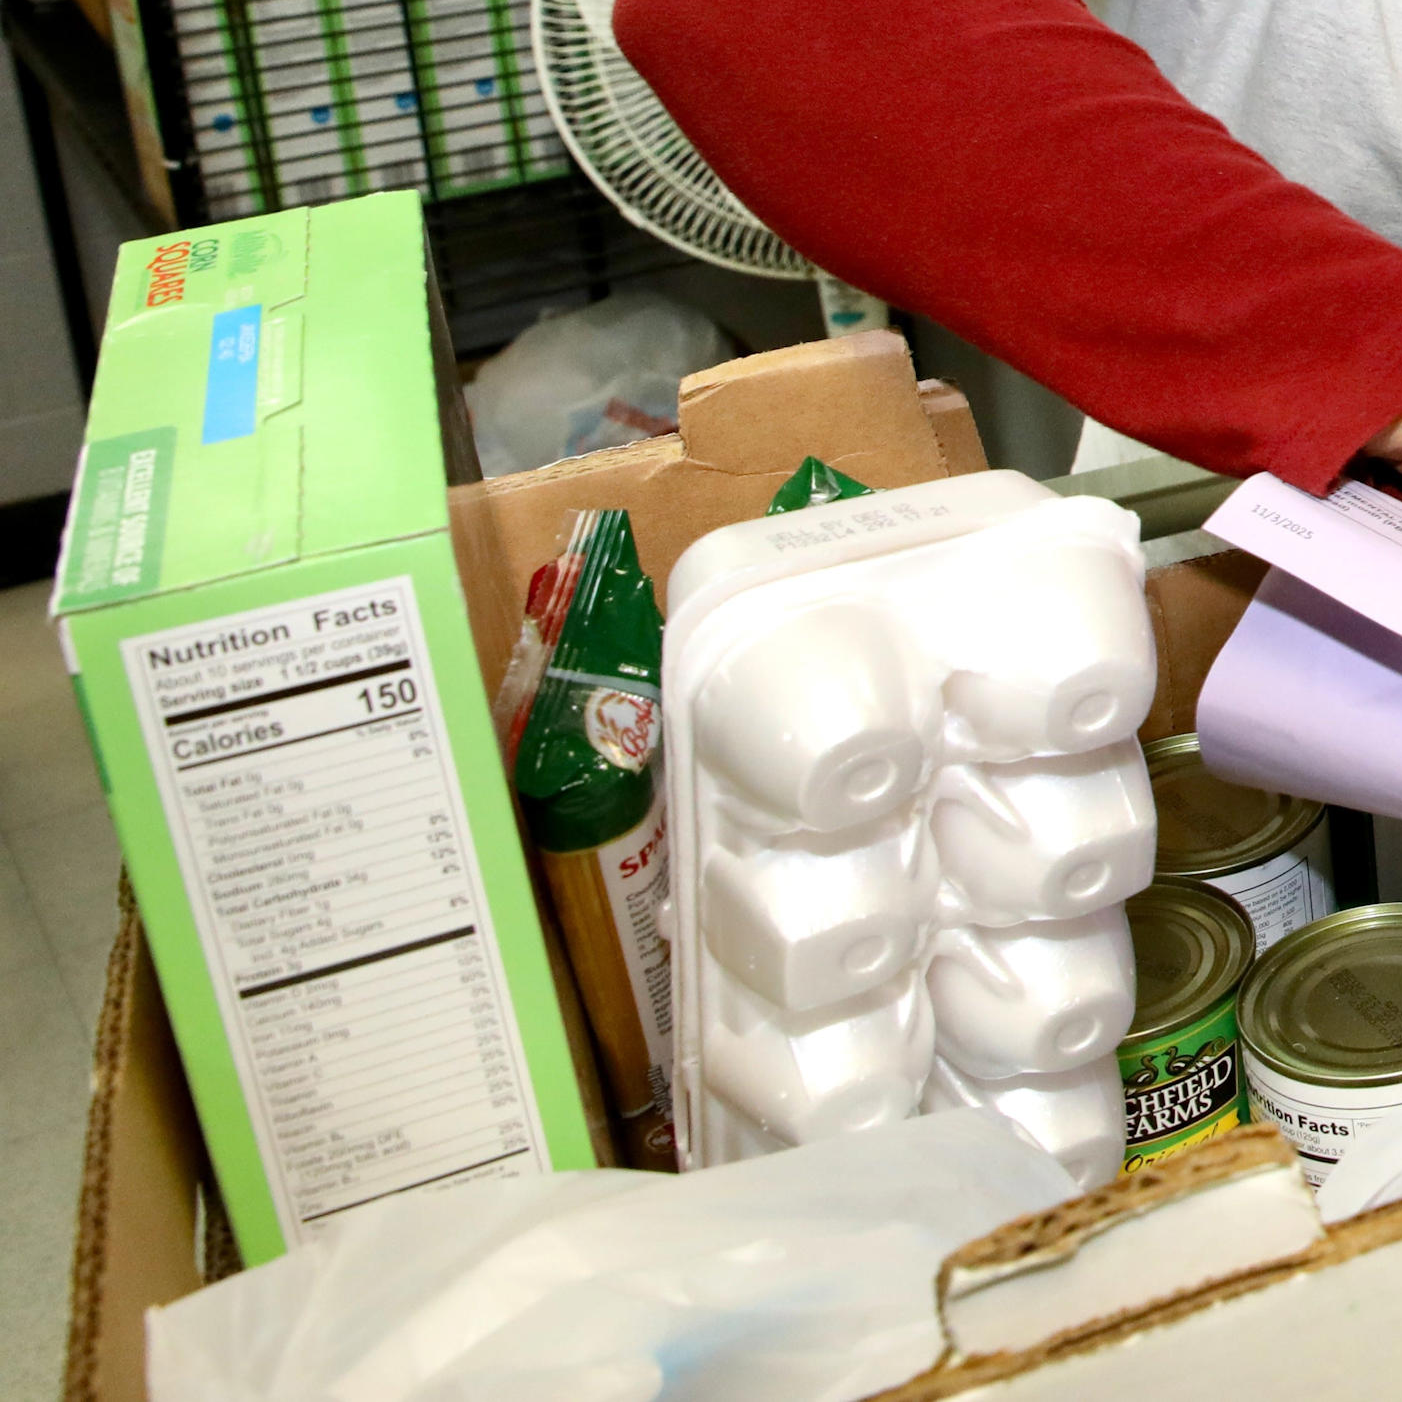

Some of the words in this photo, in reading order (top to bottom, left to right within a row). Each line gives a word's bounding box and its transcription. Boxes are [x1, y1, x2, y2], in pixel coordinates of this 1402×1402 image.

[146, 239, 192, 308] SQUARES
[190, 238, 221, 274] CORN
[1251, 503, 1315, 541] 11/3/2025
[148, 622, 290, 672] Nutrition
[311, 596, 398, 633] Facts
[160, 685, 226, 708] Serving
[231, 677, 264, 691] size
[324, 654, 363, 671] cups
[231, 652, 297, 673] servings
[173, 721, 285, 760] Calories
[357, 677, 417, 714] 150
[1299, 1114, 1350, 1138] Facts
